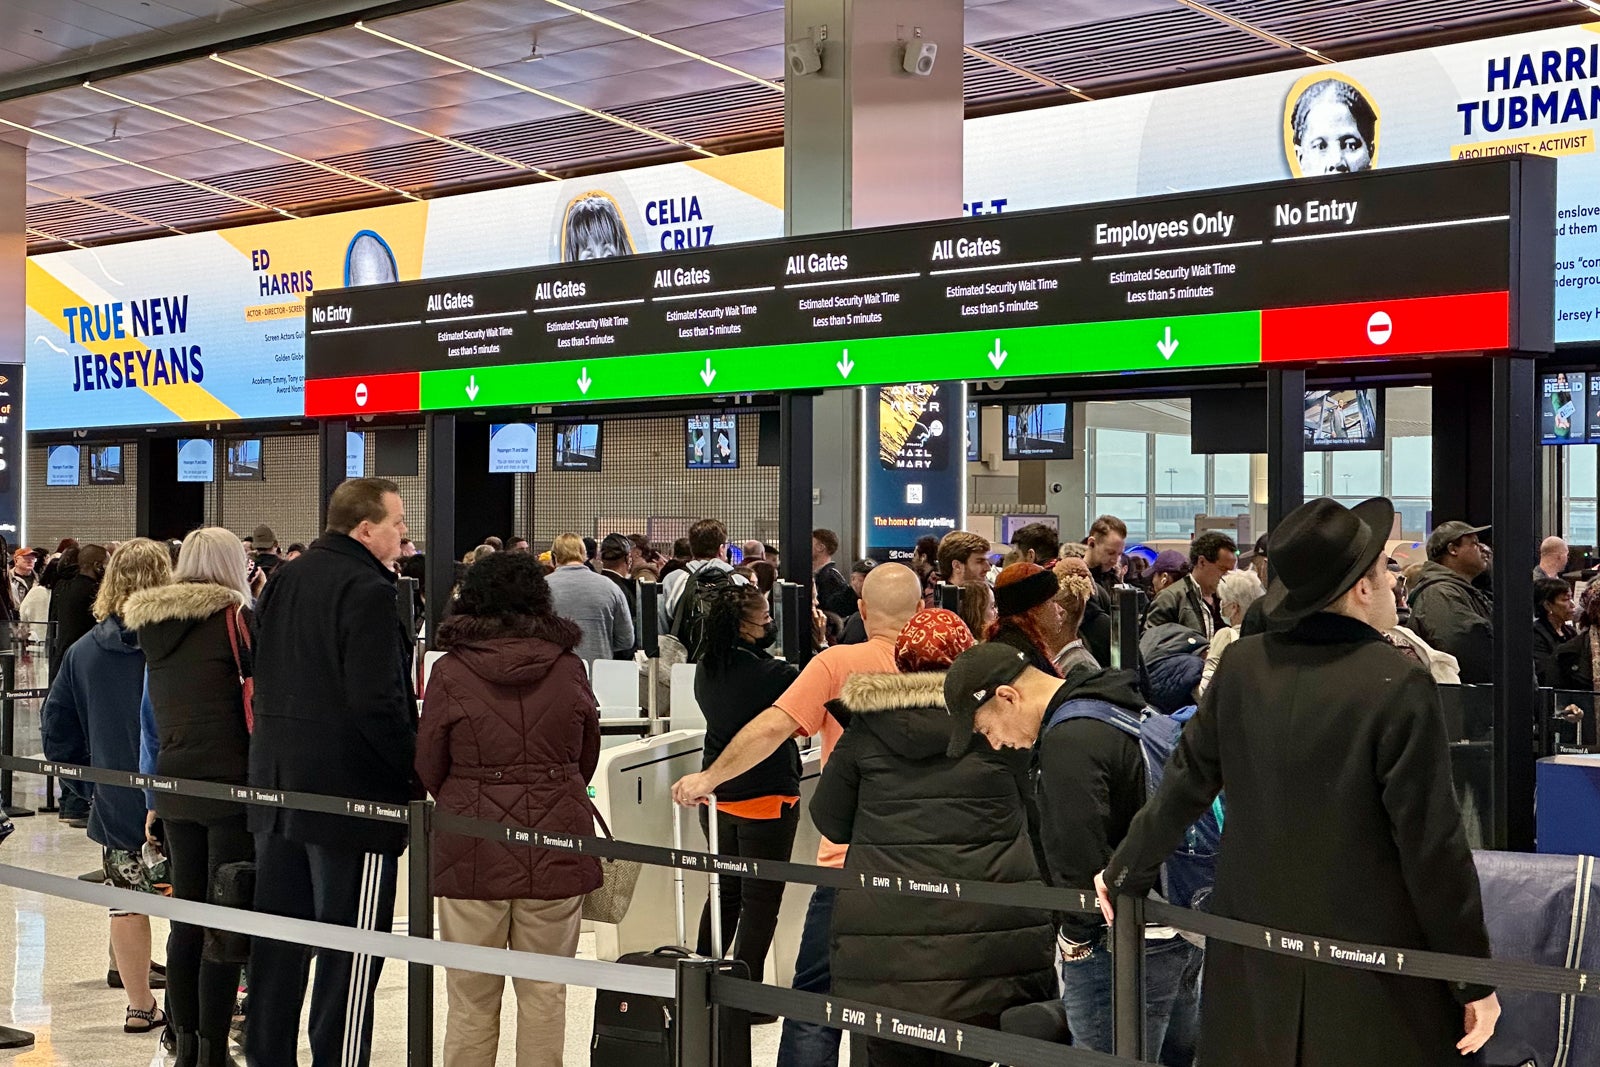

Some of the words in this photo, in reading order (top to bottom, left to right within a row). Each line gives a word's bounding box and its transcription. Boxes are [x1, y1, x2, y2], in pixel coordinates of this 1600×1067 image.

[1488, 44, 1599, 92] HARRI
[1539, 136, 1587, 152] ACTIVIST
[646, 196, 702, 226] CELIA
[1276, 204, 1302, 226] No
[1306, 200, 1358, 225] Entry
[1096, 220, 1188, 247] Employees
[1193, 211, 1234, 237] Only
[1569, 222, 1598, 235] them
[661, 225, 714, 251] CRUZ
[932, 240, 953, 260] All
[956, 238, 1000, 258] Gates
[252, 249, 270, 271] ED
[786, 256, 804, 274] All
[808, 253, 848, 273] Gates
[654, 270, 672, 288] All
[674, 268, 710, 286] Gates
[1110, 268, 1152, 284] Estimated
[1154, 266, 1189, 282] Security
[1191, 264, 1211, 278] Wait
[1212, 262, 1236, 276] Time
[259, 270, 314, 296] HARRIS
[536, 282, 550, 300] All
[553, 281, 586, 298] Gates
[946, 284, 984, 298] Estimated
[986, 282, 1017, 296] Security
[1018, 280, 1036, 292] Wait
[1037, 278, 1058, 290] Time
[427, 295, 442, 312] All
[444, 293, 474, 309] Gates
[799, 296, 834, 310] Estimated
[834, 294, 864, 308] Security
[864, 292, 880, 304] Wait
[881, 292, 900, 303] Time
[1127, 290, 1147, 303] Less
[1148, 288, 1168, 301] than
[1170, 288, 1176, 300] 5
[1177, 286, 1214, 299] minutes
[264, 306, 286, 316] DIRECTOR
[312, 306, 326, 324] No
[328, 306, 352, 324] Entry
[666, 309, 698, 322] Estimated
[698, 307, 724, 320] Security
[725, 306, 740, 316] Wait
[740, 304, 758, 314] Time
[961, 304, 978, 316] Less
[980, 302, 998, 315] than
[998, 302, 1005, 313] 5
[1006, 300, 1038, 312] minutes
[1557, 310, 1592, 322] Jersey
[63, 302, 126, 344] TRUE
[131, 294, 188, 338] NEW
[547, 320, 575, 333] Estimated
[576, 318, 598, 331] Security
[599, 317, 613, 327] Wait
[613, 316, 628, 326] Time
[813, 316, 828, 328] Less
[830, 314, 846, 326] than
[846, 314, 852, 325] 5
[853, 312, 882, 324] minutes
[264, 334, 279, 342] Screen
[438, 330, 463, 342] Estimated
[464, 328, 485, 340] Security
[486, 328, 498, 338] Wait
[498, 326, 513, 336] Time
[678, 327, 692, 338] Less
[693, 326, 708, 337] than
[709, 326, 714, 335] 5
[715, 324, 741, 335] minutes
[558, 338, 570, 348] Less
[571, 336, 584, 347] than
[585, 336, 590, 346] 5
[590, 334, 614, 344] minutes
[448, 346, 459, 356] Less
[461, 346, 472, 356] than
[473, 345, 477, 354] 5
[478, 344, 500, 354] minutes
[73, 345, 204, 392] JERSEYANS
[288, 375, 298, 383] Tony
[1572, 382, 1582, 392] ID
[1, 404, 11, 414] of
[897, 449, 932, 457] HAIL
[897, 460, 932, 468] MARY
[874, 517, 887, 526] The
[889, 517, 908, 526] home
[909, 517, 916, 526] of
[354, 804, 365, 813] EWR
[376, 807, 396, 817] Terminal
[516, 832, 528, 841] EWR
[543, 836, 568, 848] Terminal
[568, 838, 573, 848] A
[682, 855, 697, 866] EWR
[714, 859, 741, 872] Terminal
[741, 862, 748, 872] A
[873, 877, 890, 887] EWR
[909, 880, 942, 893] Terminal
[943, 884, 949, 894] A
[1281, 937, 1303, 952] EWR
[1330, 946, 1376, 964] Terminal
[1377, 953, 1386, 966] A
[842, 1008, 865, 1026] EWR
[891, 1018, 936, 1041] Terminal
[937, 1028, 946, 1044] A
